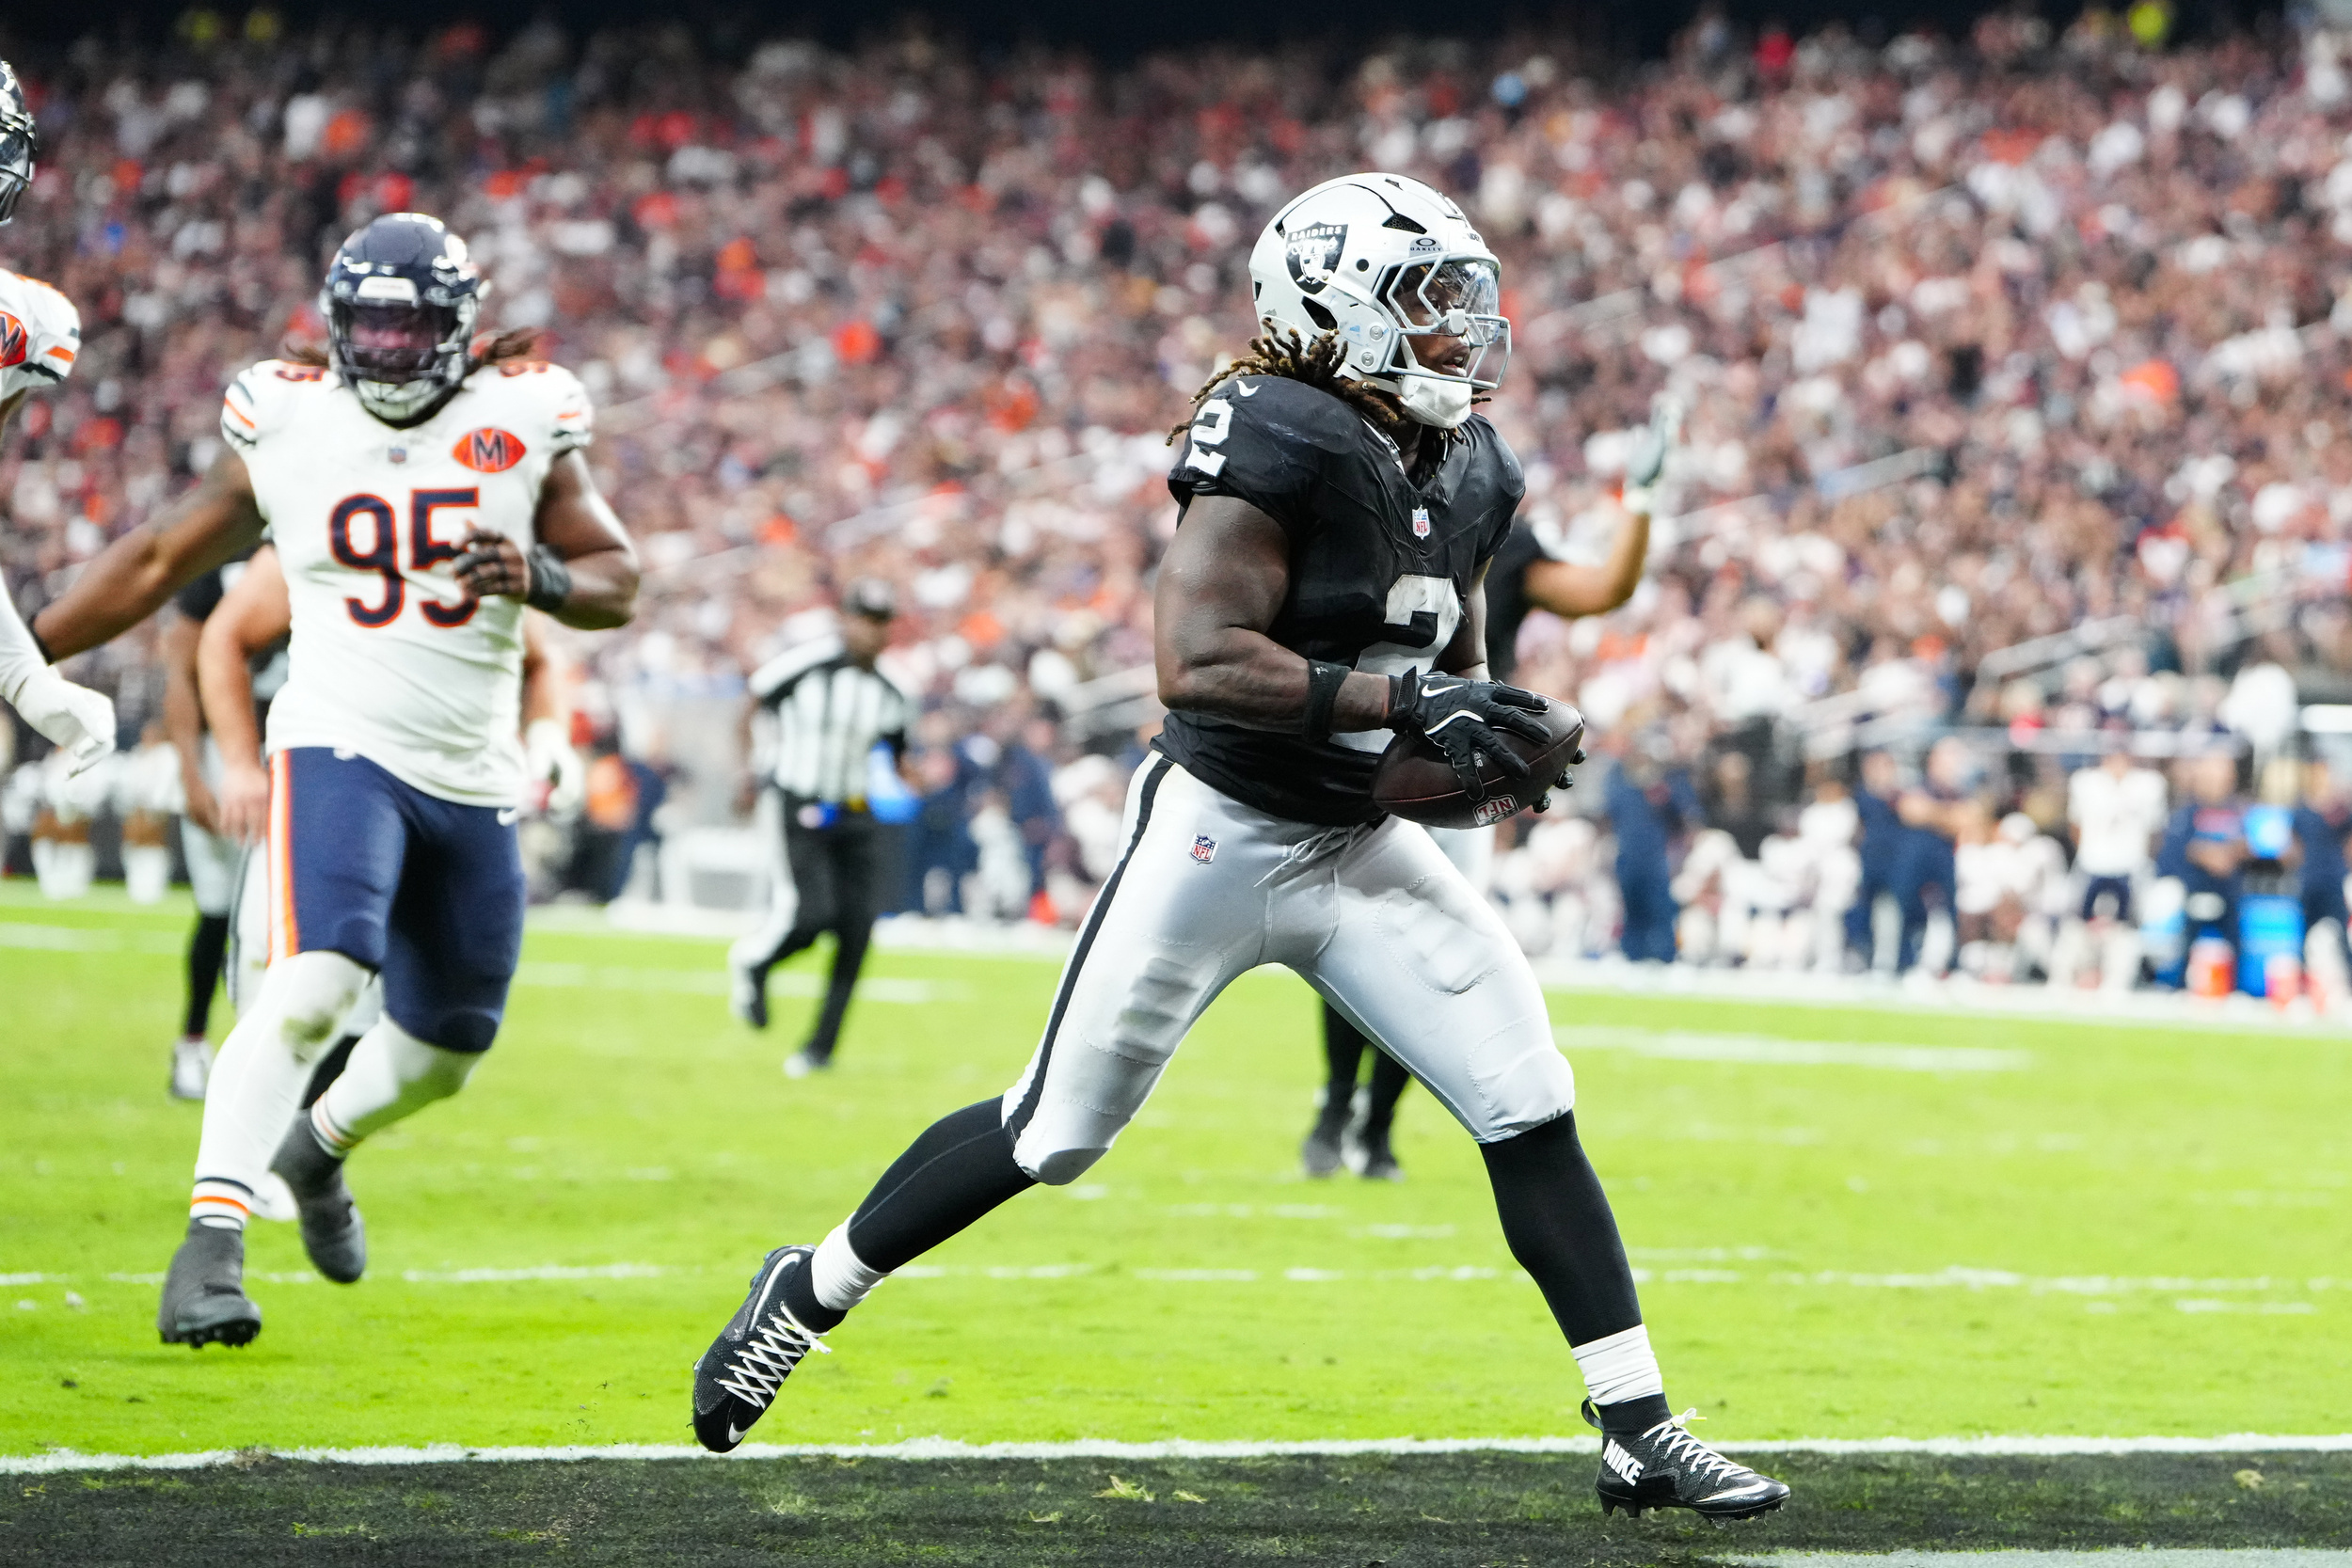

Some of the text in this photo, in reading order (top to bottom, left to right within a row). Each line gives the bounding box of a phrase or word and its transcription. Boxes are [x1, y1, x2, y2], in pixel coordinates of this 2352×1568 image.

[1291, 226, 1343, 242] RAIDERS
[473, 430, 506, 468] M
[1184, 398, 1234, 477] 2
[1415, 520, 1428, 533] NFL
[328, 486, 480, 629] 95
[1327, 574, 1460, 755] 2
[1478, 797, 1513, 819] NFL
[1192, 844, 1211, 860] NFL
[1602, 1437, 1645, 1486] NIKE
